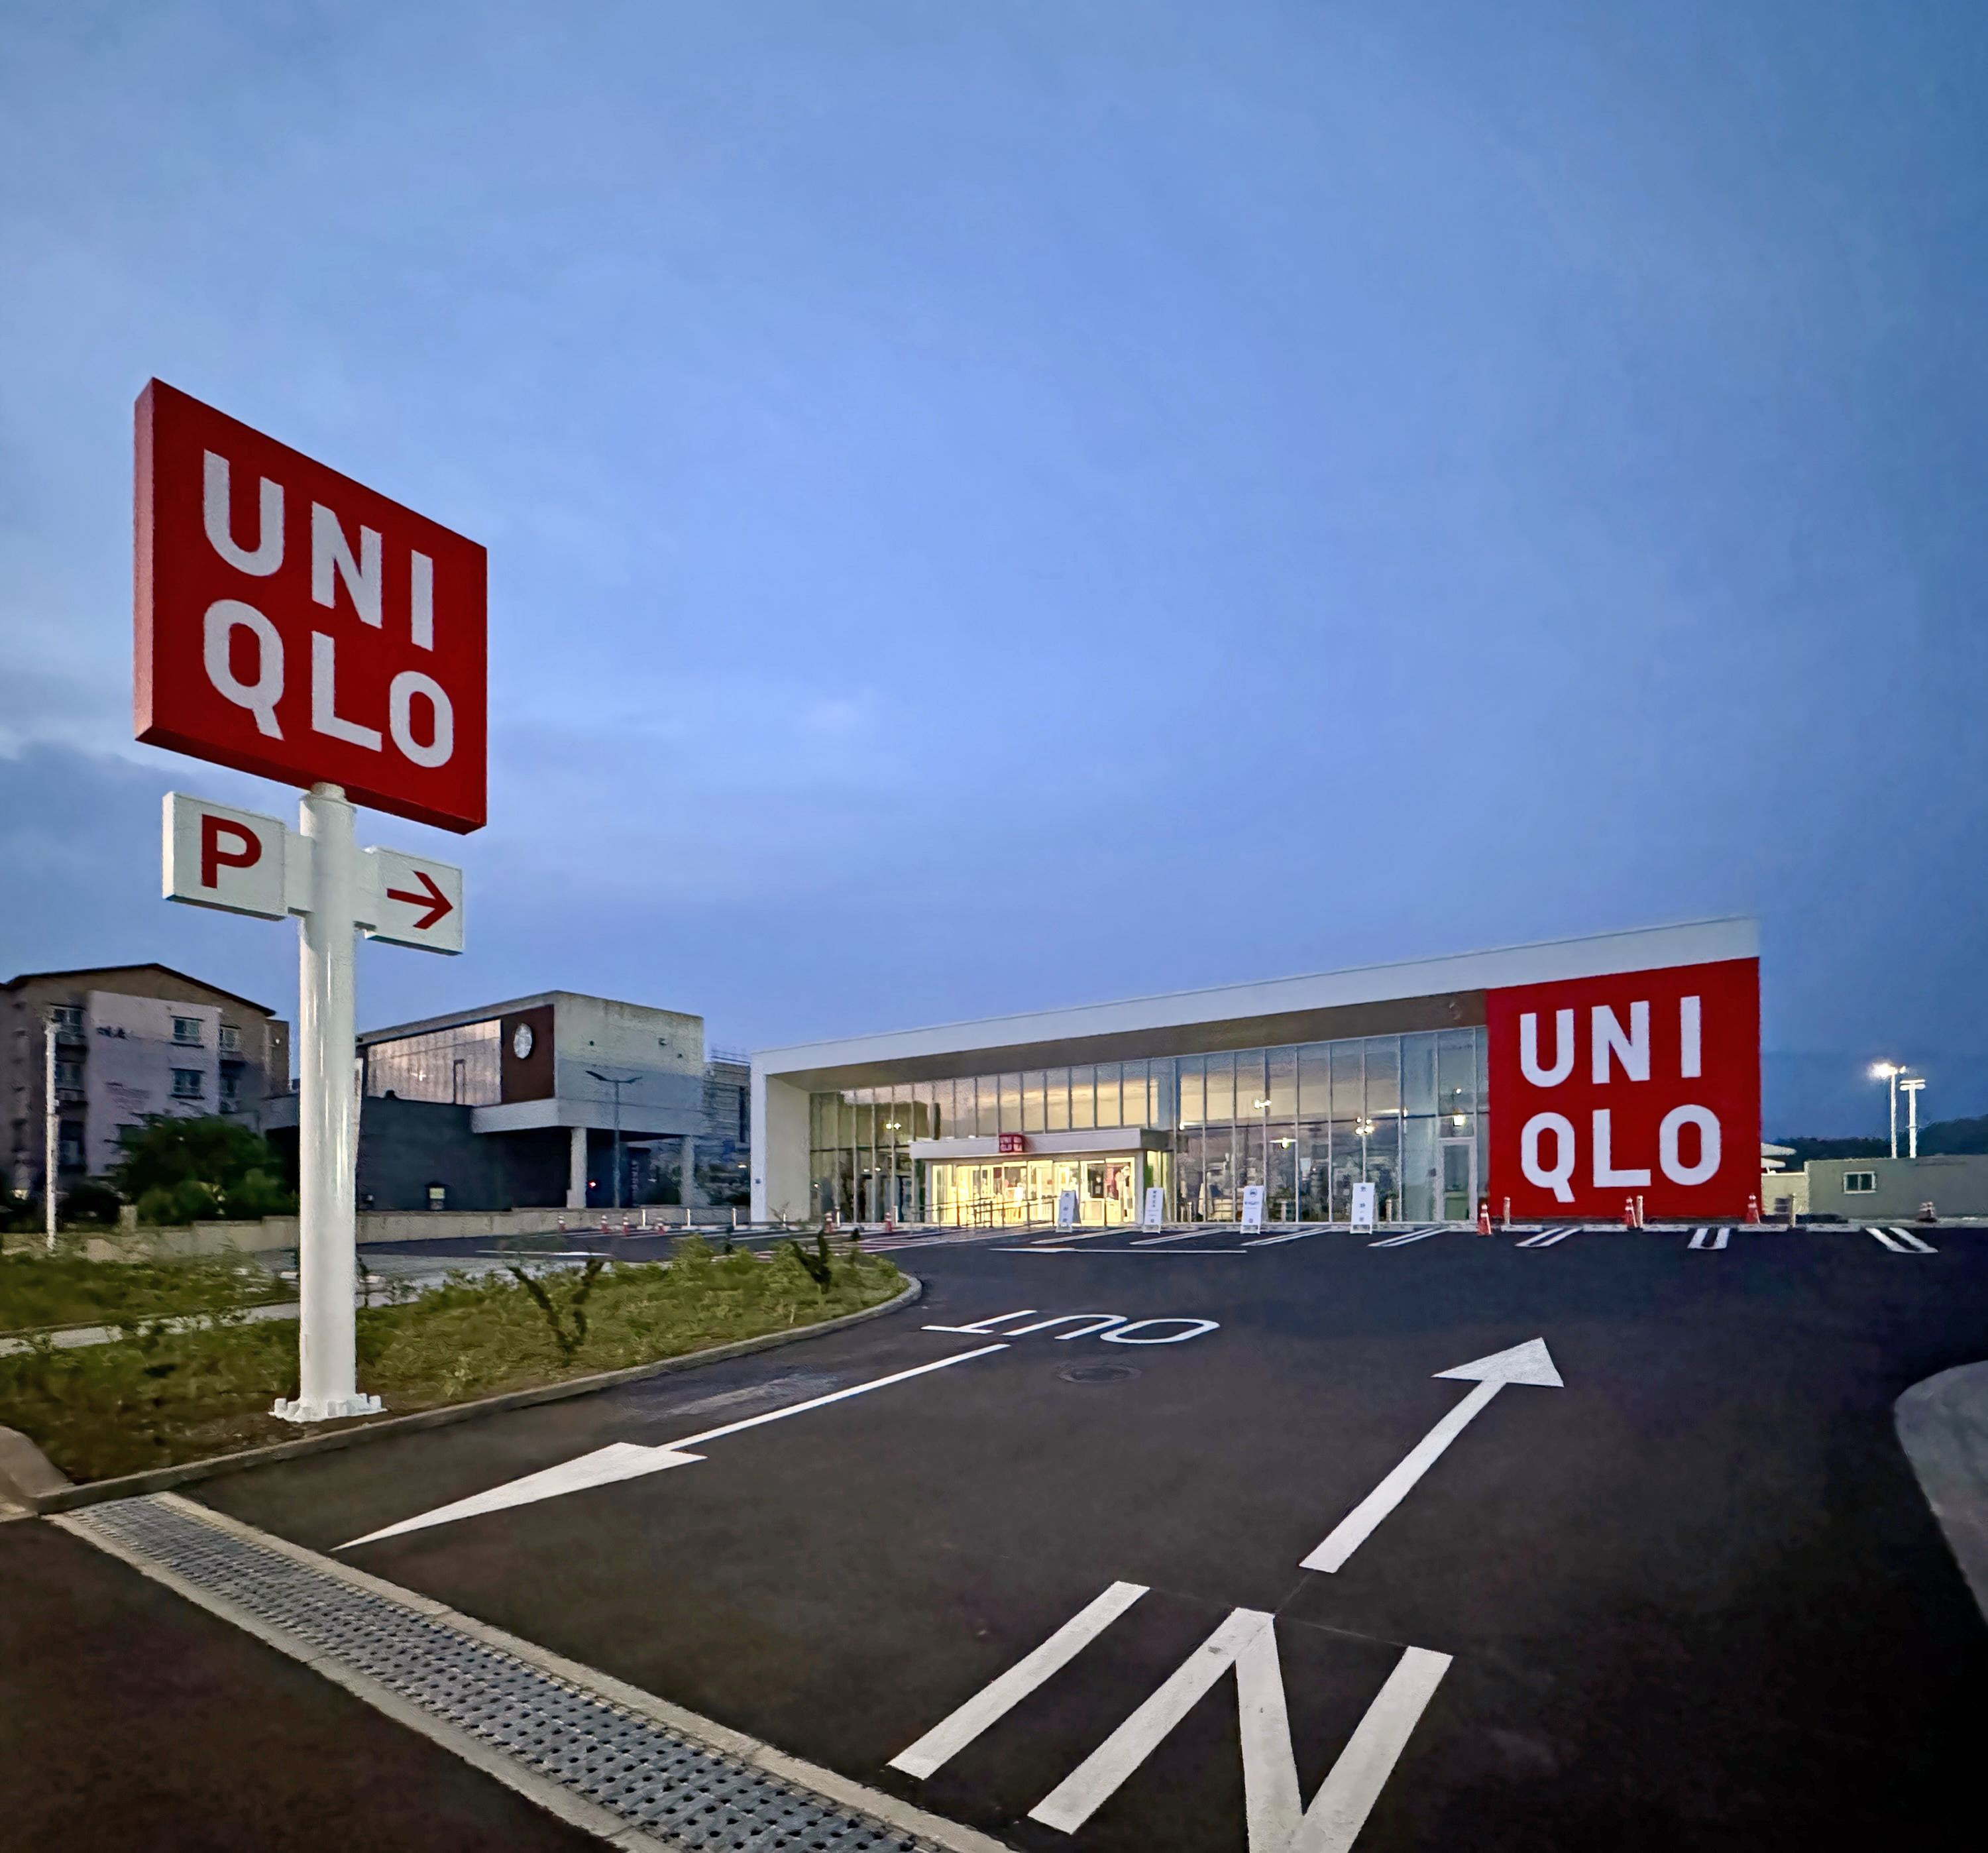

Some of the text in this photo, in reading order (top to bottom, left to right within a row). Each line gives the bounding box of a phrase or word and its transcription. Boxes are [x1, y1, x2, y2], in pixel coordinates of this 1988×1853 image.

[203, 449, 433, 651] UNI
[203, 599, 454, 768] QLO
[201, 814, 262, 889] P
[1519, 995, 1702, 1088] UNI
[1521, 1104, 1722, 1203] QLO
[920, 1310, 1221, 1344] OUT
[886, 1580, 1455, 1853] IN
